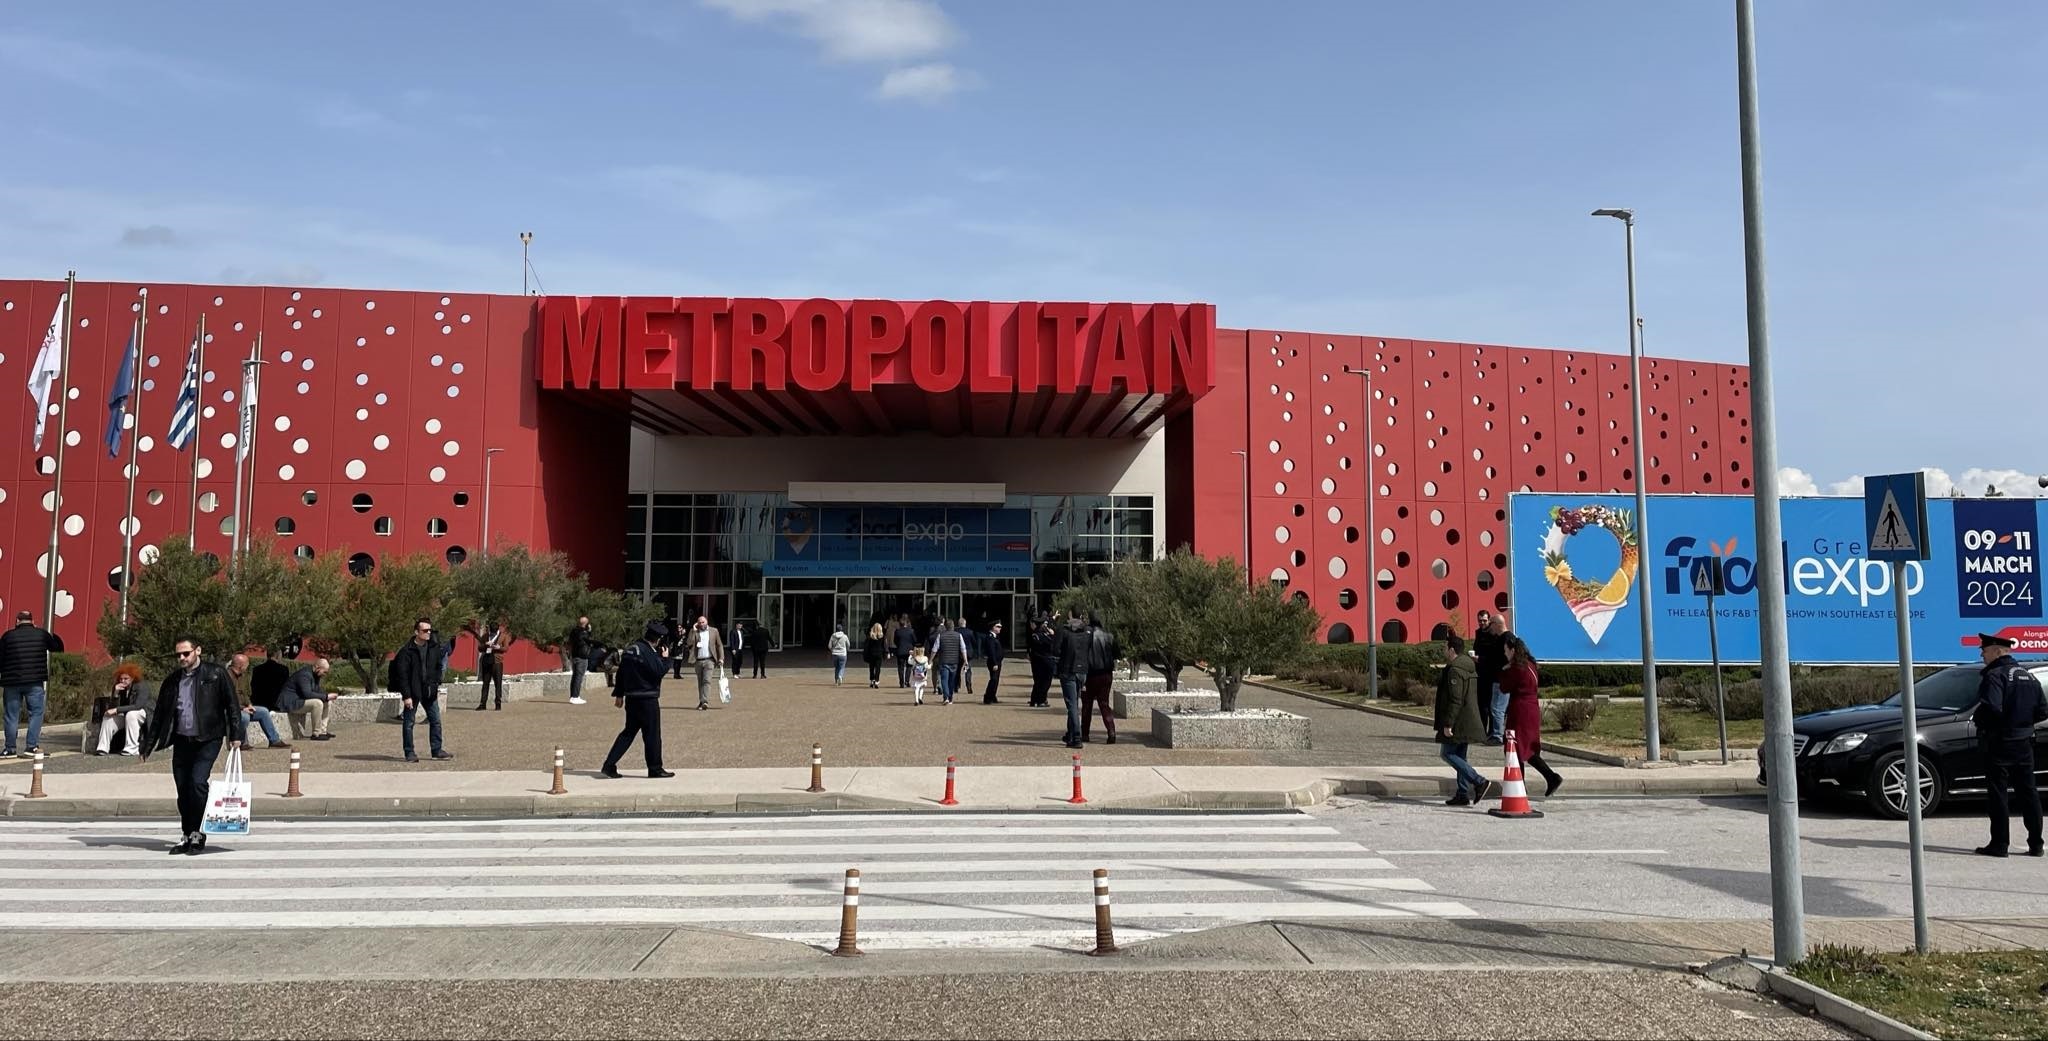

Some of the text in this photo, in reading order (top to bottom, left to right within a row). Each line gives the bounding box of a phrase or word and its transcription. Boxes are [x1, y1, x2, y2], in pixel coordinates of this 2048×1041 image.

[540, 296, 1209, 394] METROPOLITAN
[1965, 556, 2033, 574] MARCH
[1967, 581, 2034, 606] 2024
[1667, 608, 1686, 617] THE
[1732, 609, 1751, 618] F&B
[1786, 609, 1815, 618] SHOW
[1818, 610, 1828, 618] IN
[1830, 610, 1885, 619] SOUTHEAST
